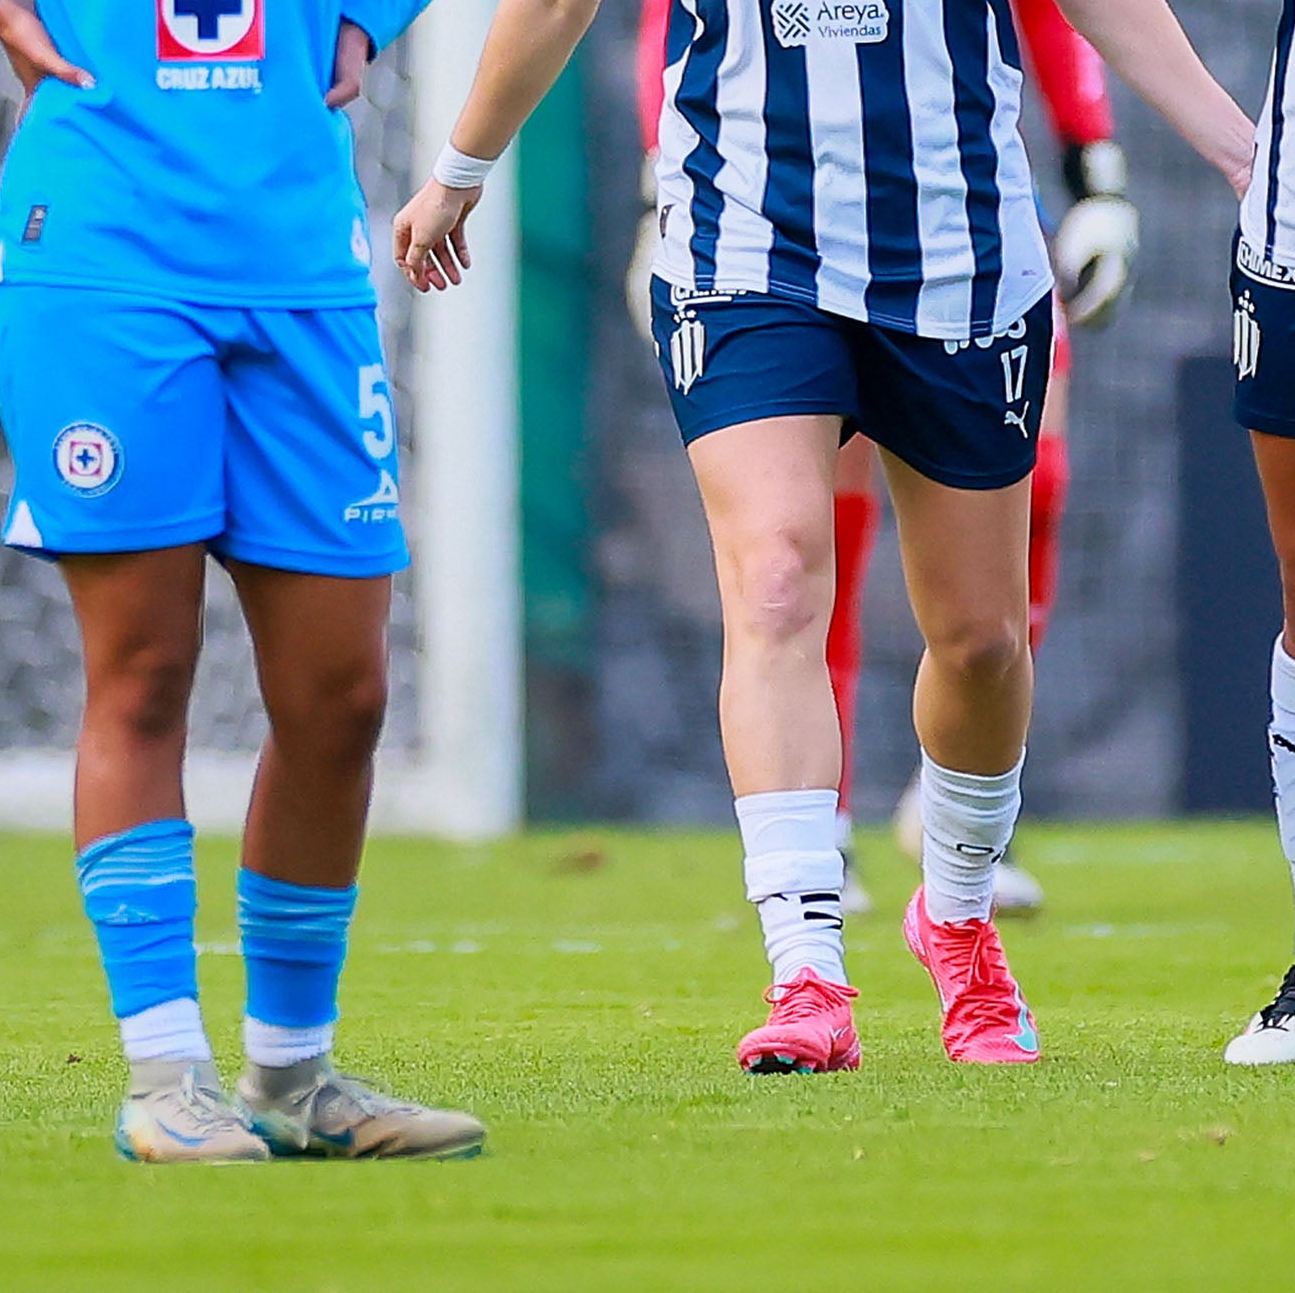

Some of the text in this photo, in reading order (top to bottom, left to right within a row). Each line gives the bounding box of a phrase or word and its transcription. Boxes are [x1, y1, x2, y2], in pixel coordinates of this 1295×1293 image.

[816, 1, 880, 23] Areya
[817, 24, 882, 39] Viviendas
[156, 66, 262, 90] CRUZ AZUL
[1000, 344, 1028, 403] 17
[358, 362, 394, 459] 5
